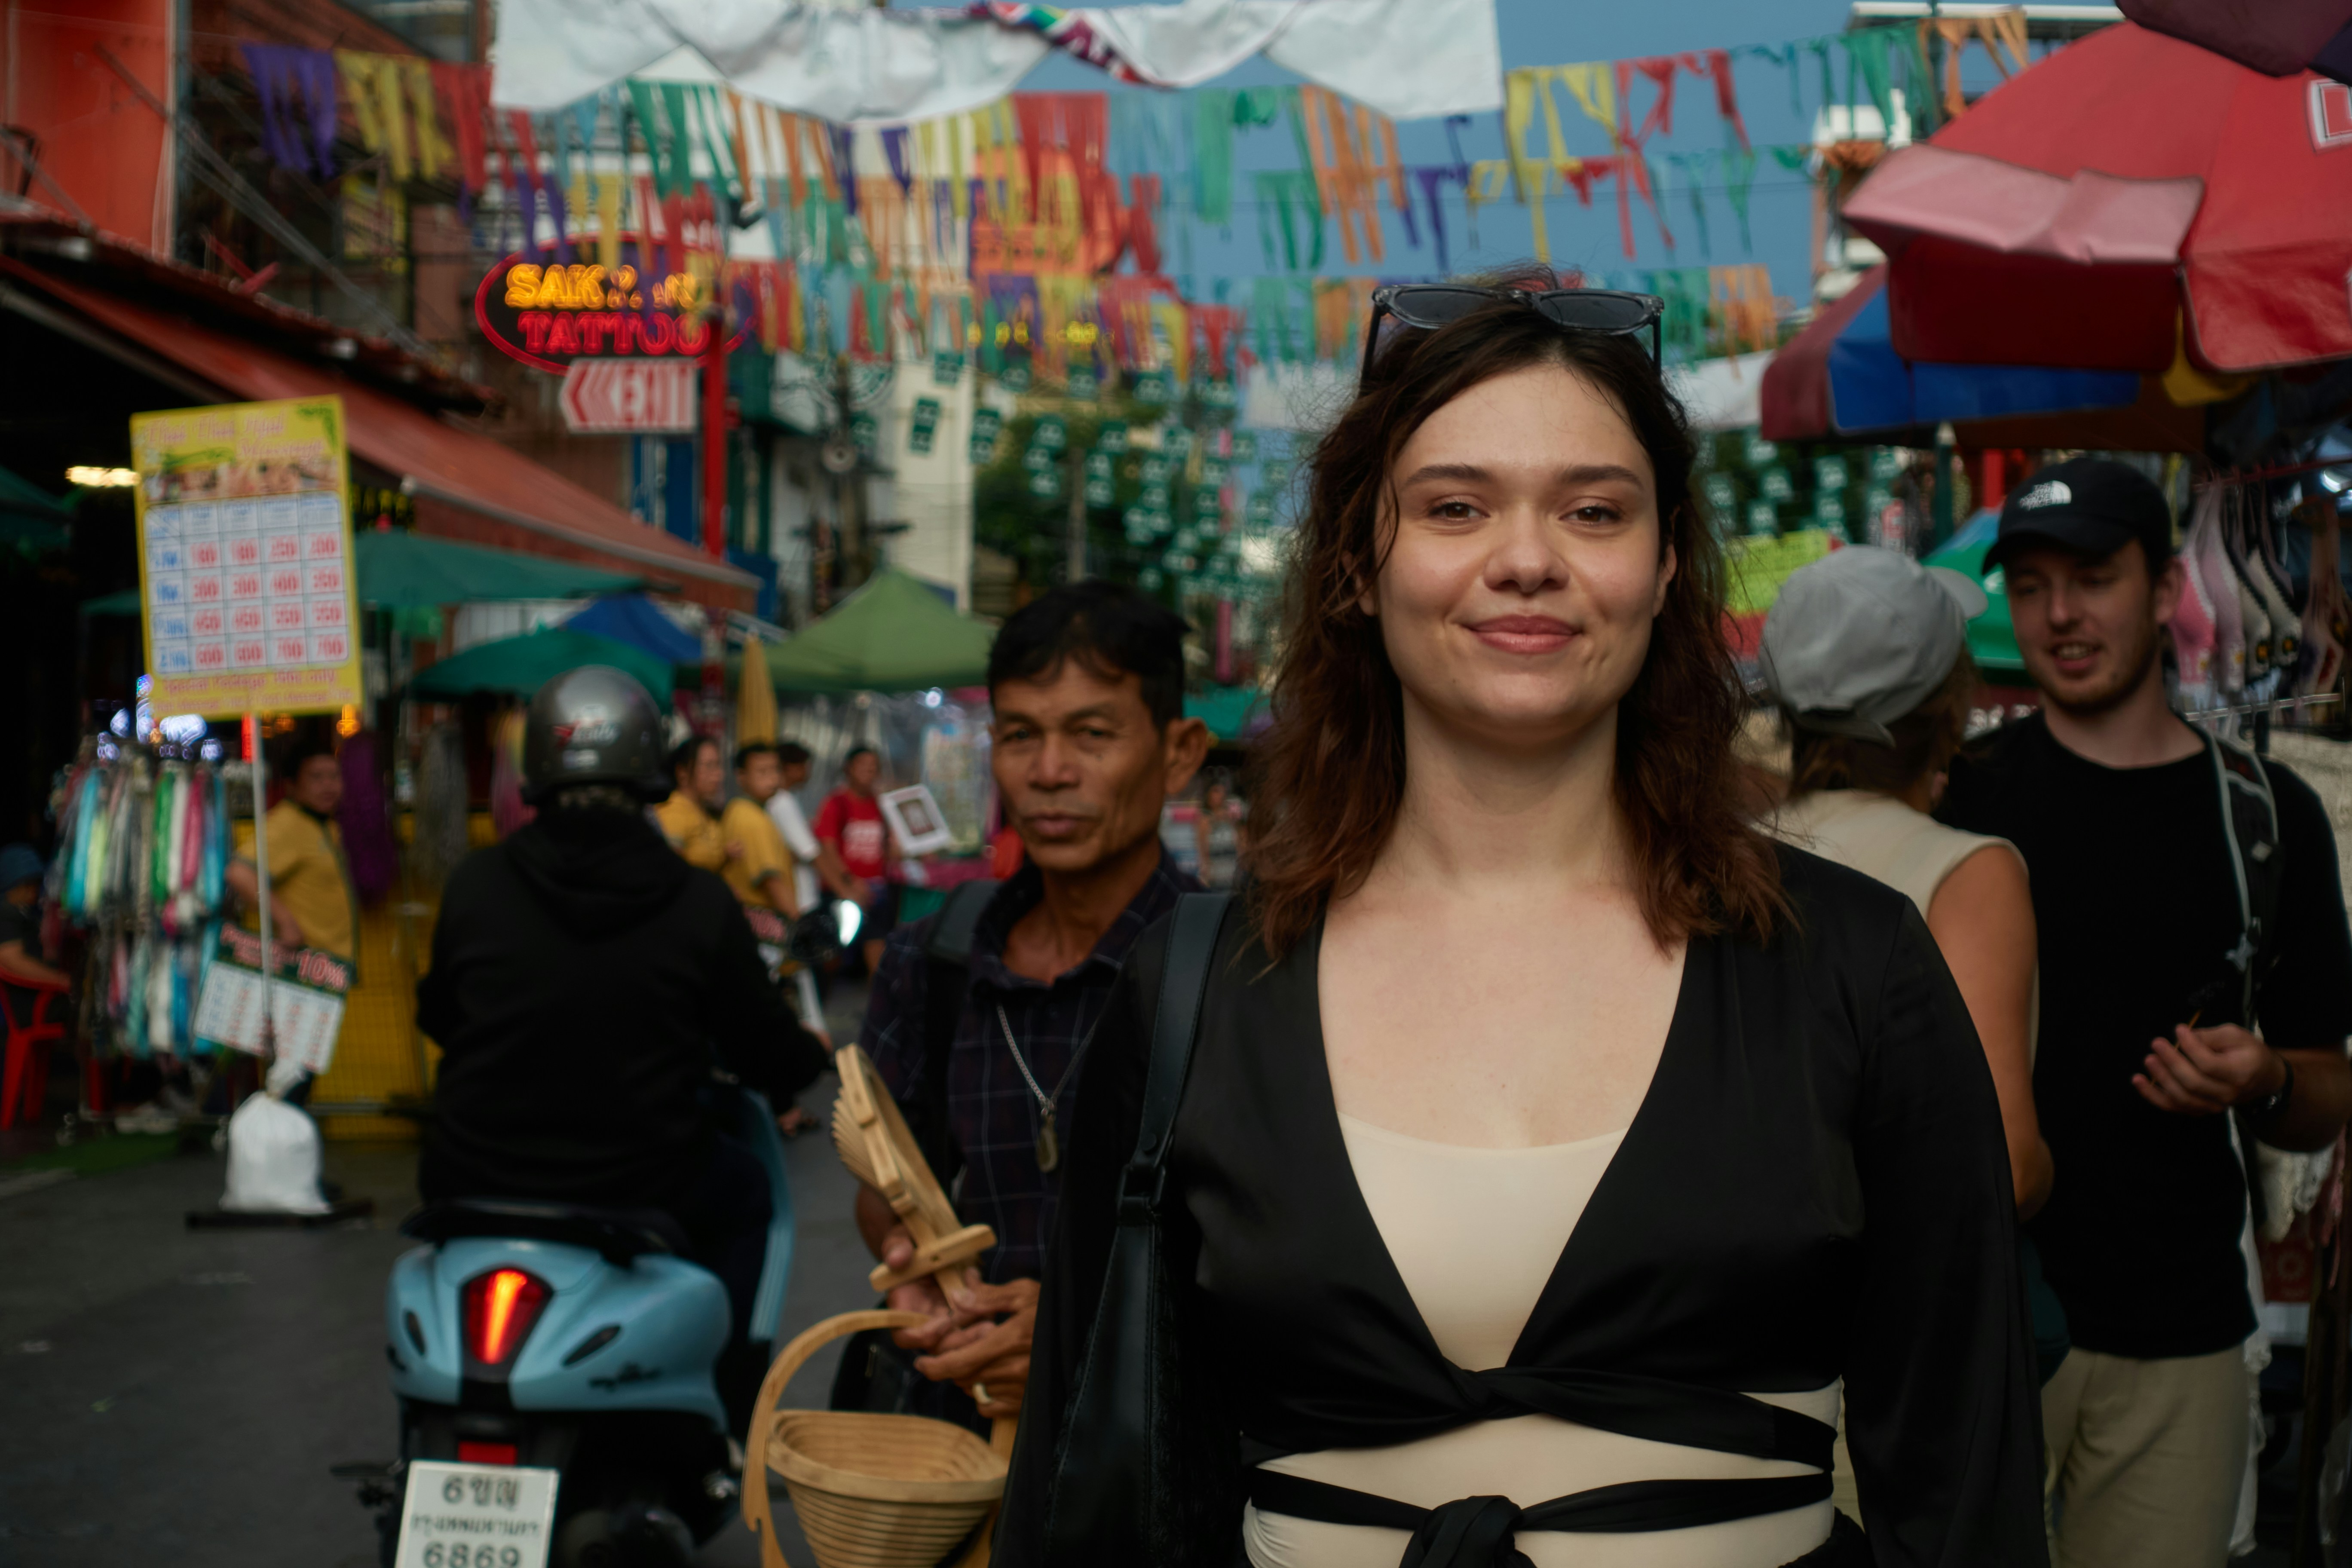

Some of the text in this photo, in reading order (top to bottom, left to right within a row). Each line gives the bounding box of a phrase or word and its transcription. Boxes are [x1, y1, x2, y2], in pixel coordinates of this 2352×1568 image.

[518, 310, 712, 355] TATTOO
[618, 365, 693, 428] EXIT
[423, 1541, 521, 1568] 6869
